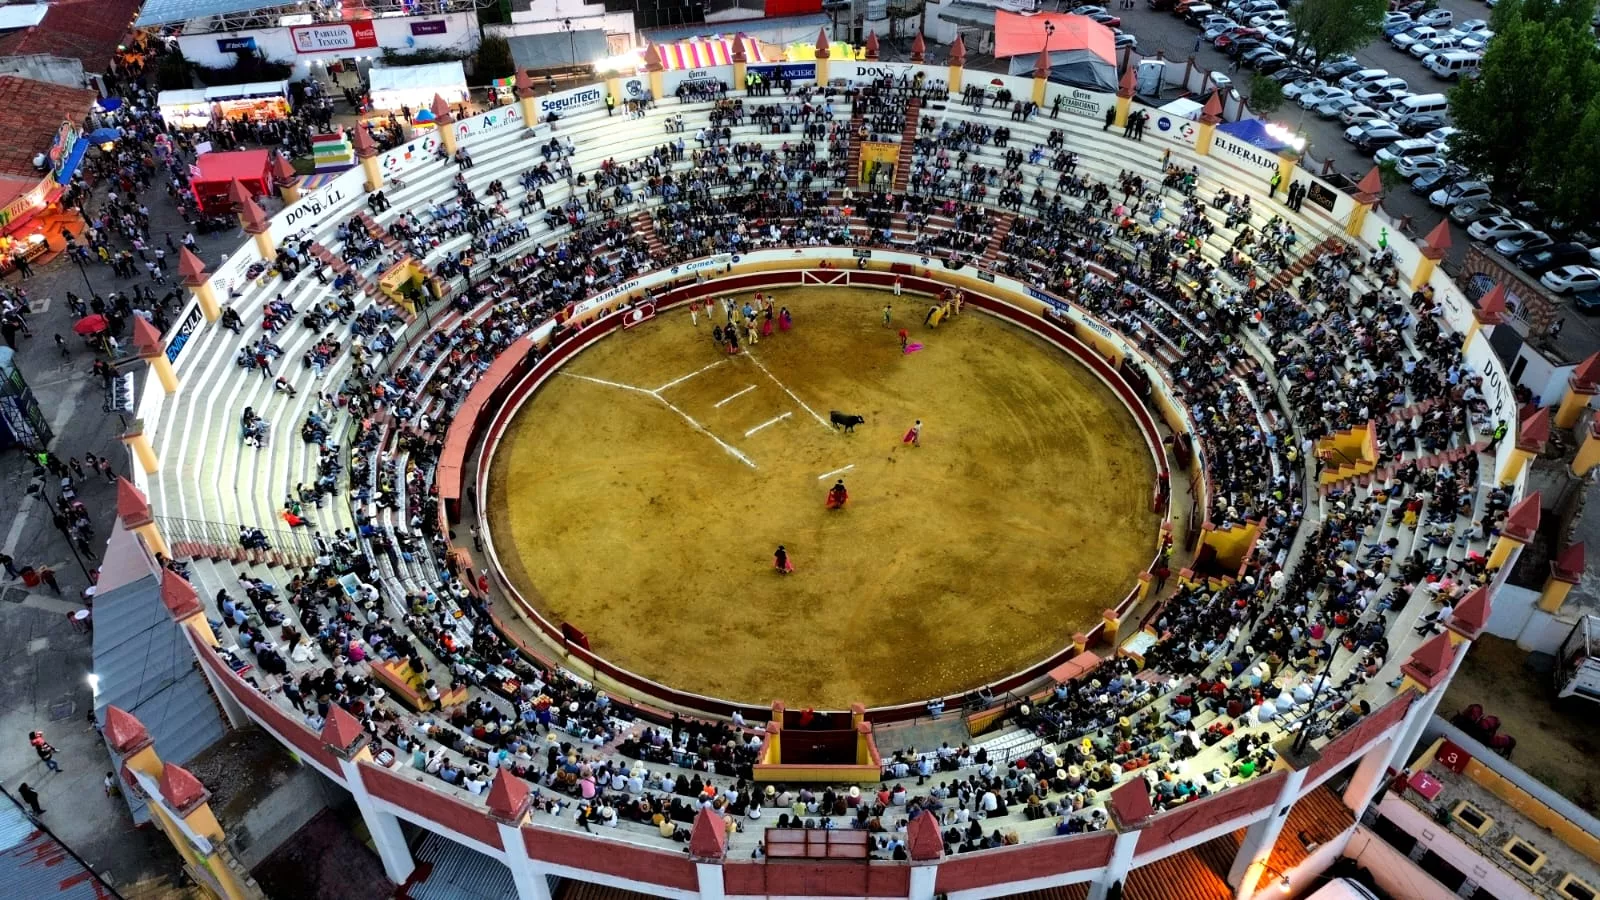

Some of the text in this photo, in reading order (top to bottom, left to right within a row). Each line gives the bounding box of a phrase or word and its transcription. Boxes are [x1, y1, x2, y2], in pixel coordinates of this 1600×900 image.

[856, 66, 886, 78] DON
[541, 89, 601, 112] SeguriTech
[1215, 136, 1228, 150] EL
[1228, 143, 1280, 172] HERALDO
[686, 260, 715, 271] Comex
[604, 280, 640, 299] HERALDO
